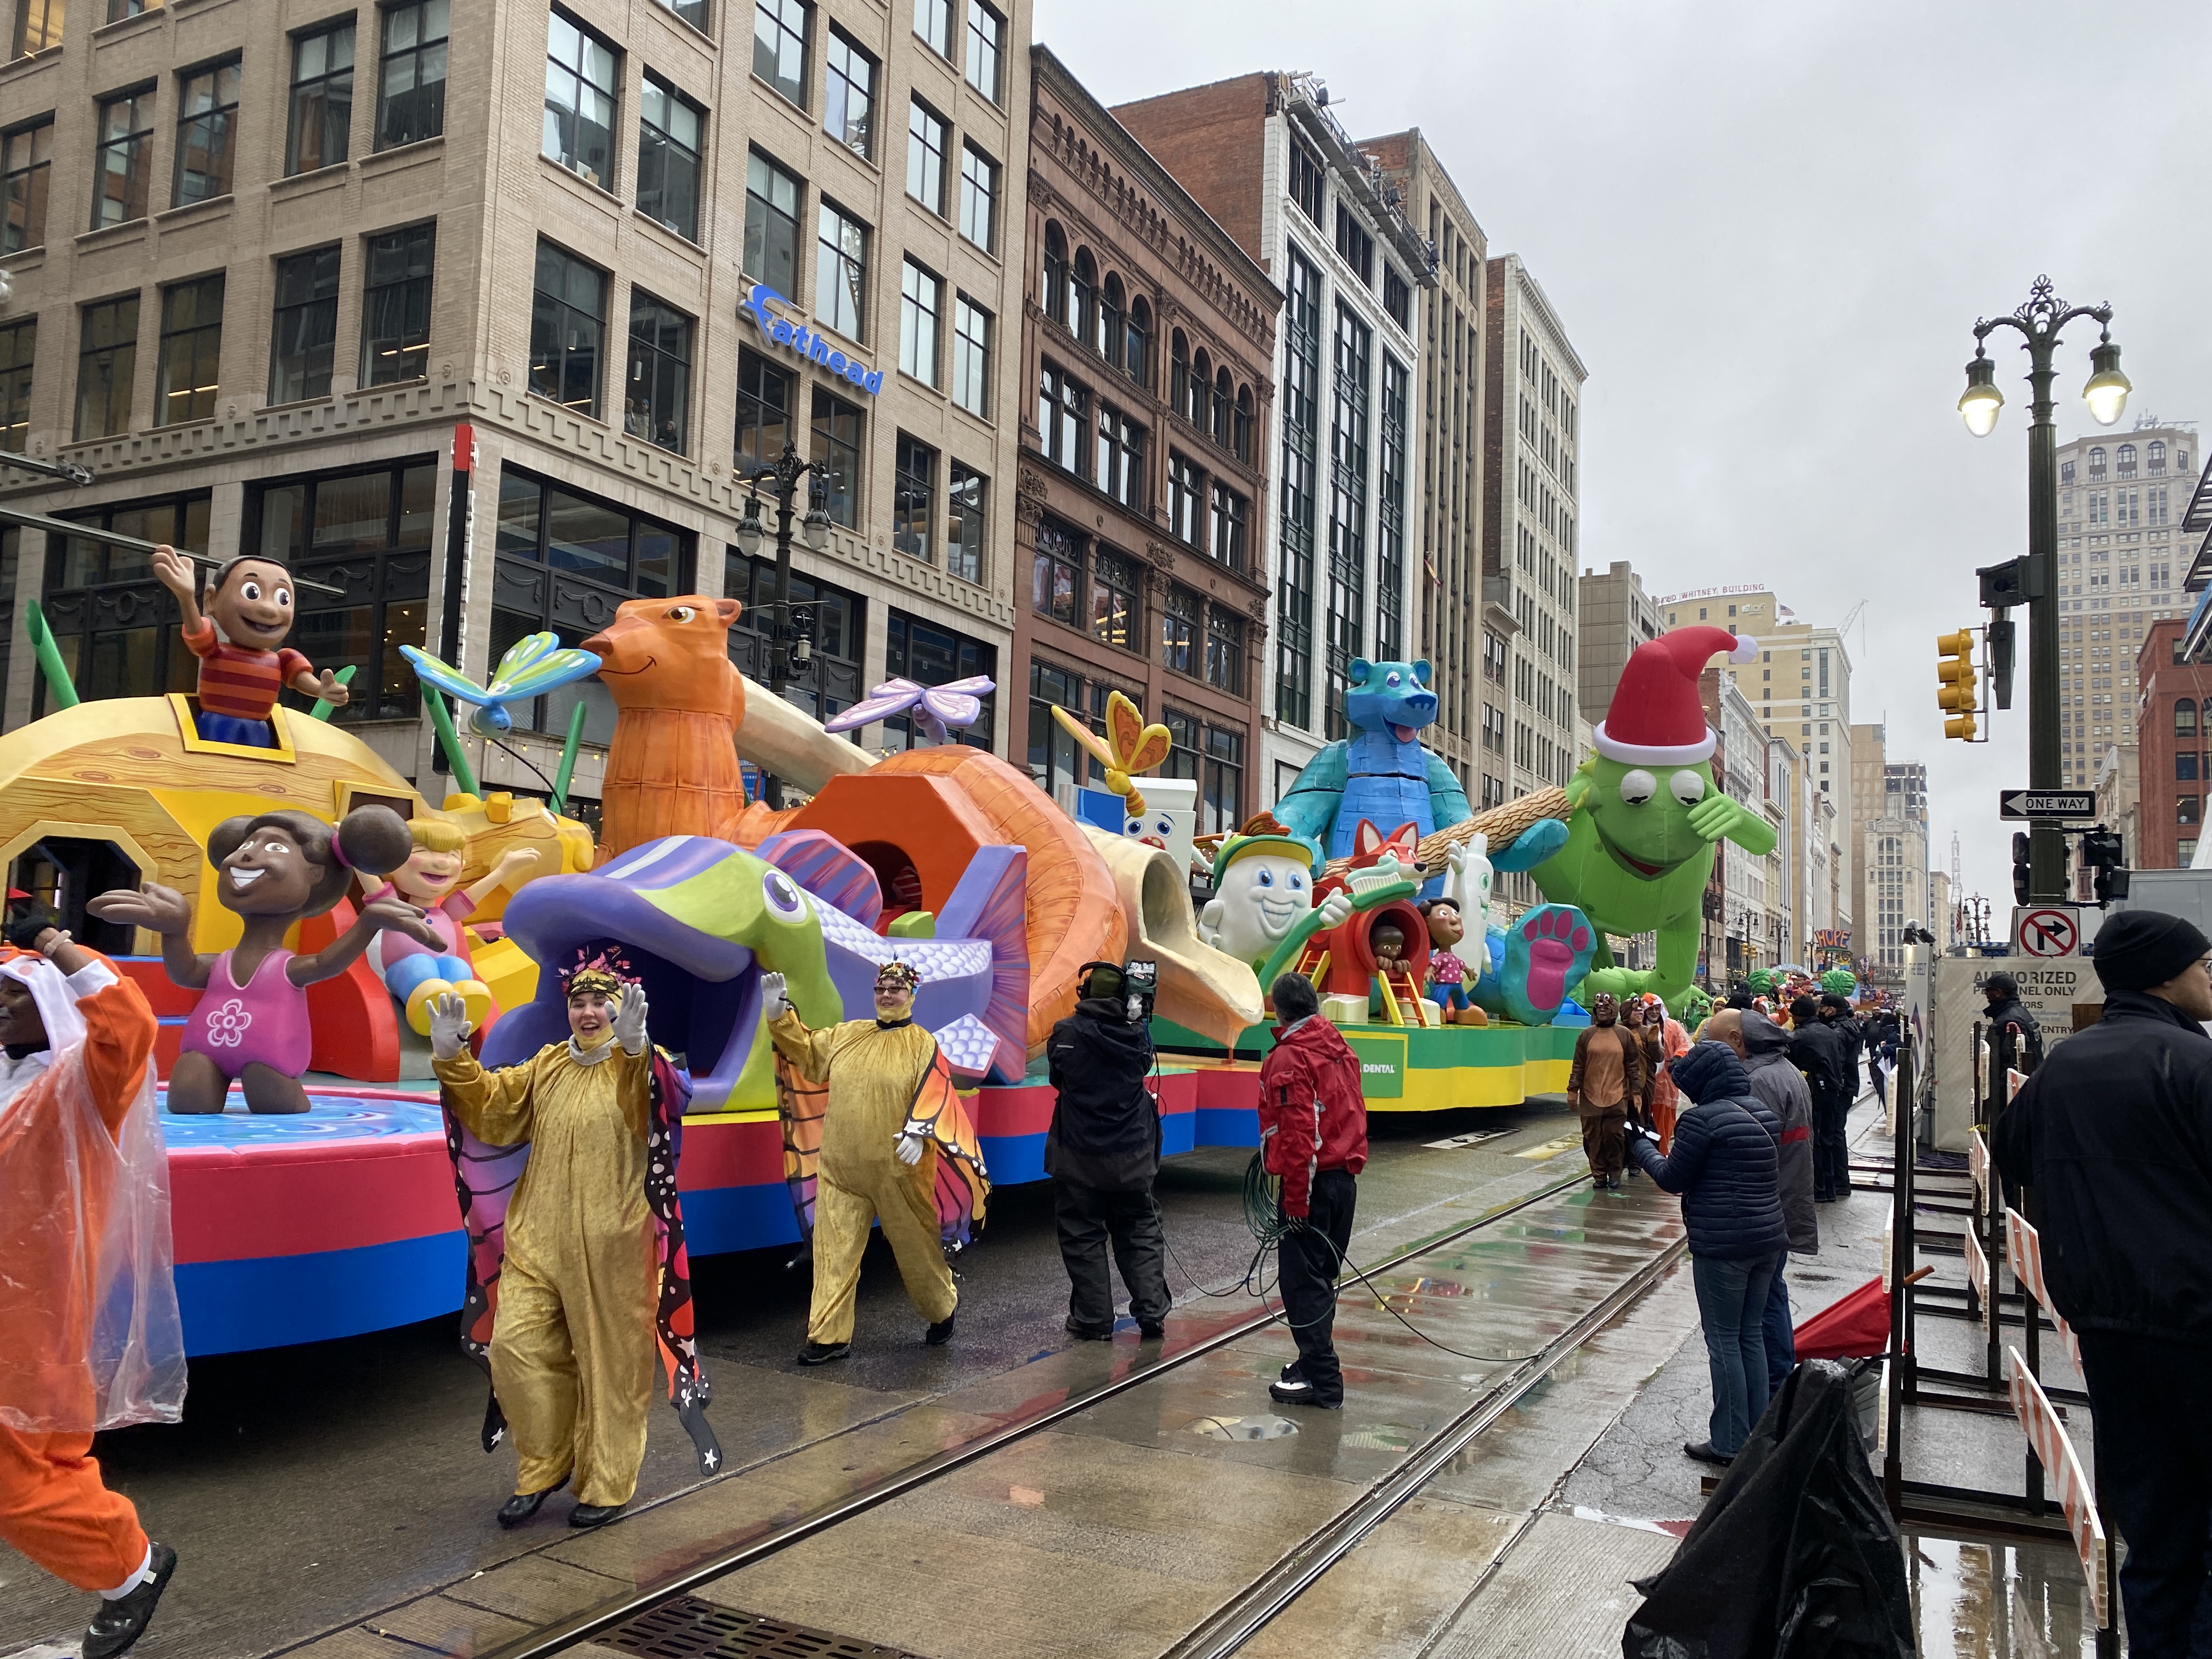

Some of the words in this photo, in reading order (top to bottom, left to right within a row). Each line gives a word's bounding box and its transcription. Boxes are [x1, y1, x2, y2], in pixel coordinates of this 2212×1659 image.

[739, 285, 884, 396] Fathead
[1681, 587, 1717, 599] WHITNEY
[1723, 583, 1764, 593] BUILDING
[2026, 798, 2053, 809] ONE
[2058, 798, 2085, 809] WAY
[1815, 929, 1852, 948] HOPE
[2045, 987, 2076, 996] ONLY
[2041, 1025, 2074, 1034] ENTRY
[1363, 1064, 1395, 1073] DENTAL
